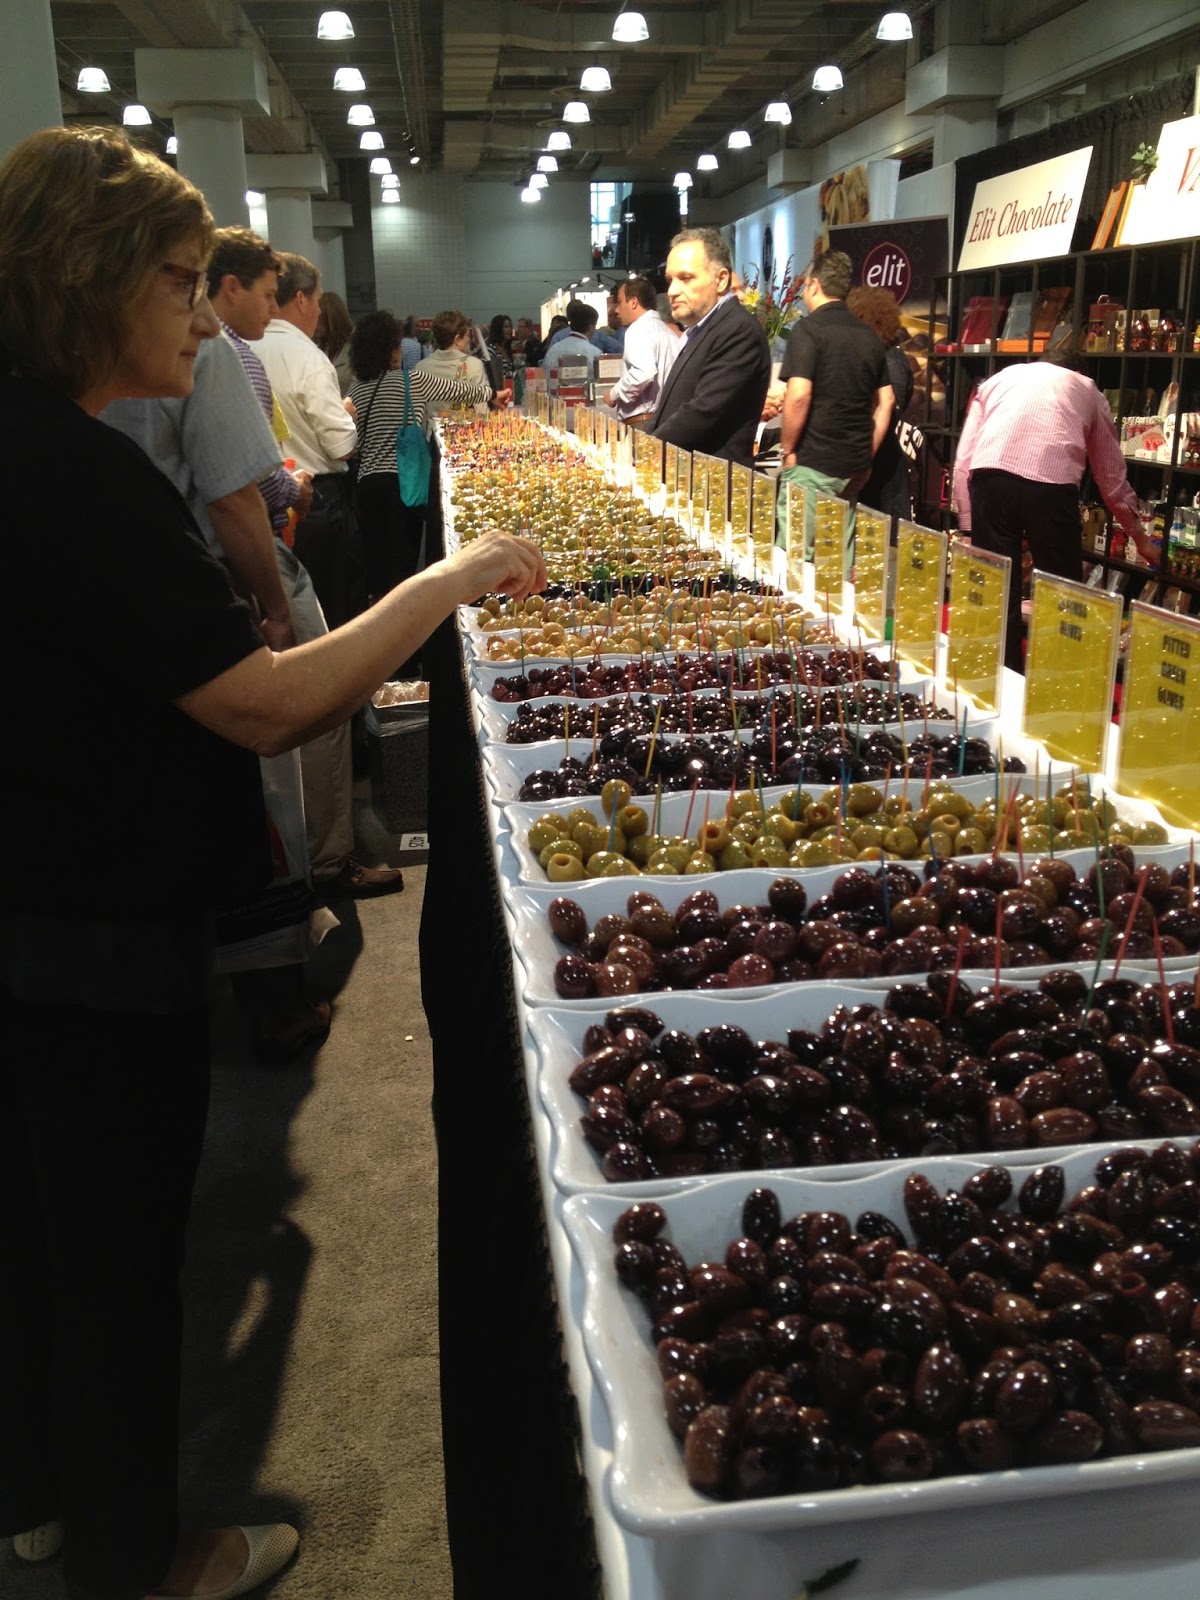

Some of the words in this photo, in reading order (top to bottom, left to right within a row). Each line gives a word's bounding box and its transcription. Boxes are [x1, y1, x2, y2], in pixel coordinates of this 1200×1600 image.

[968, 207, 997, 243] Elit
[997, 191, 1073, 237] Chocolate
[866, 254, 906, 288] elit
[1163, 635, 1191, 660] PITTED
